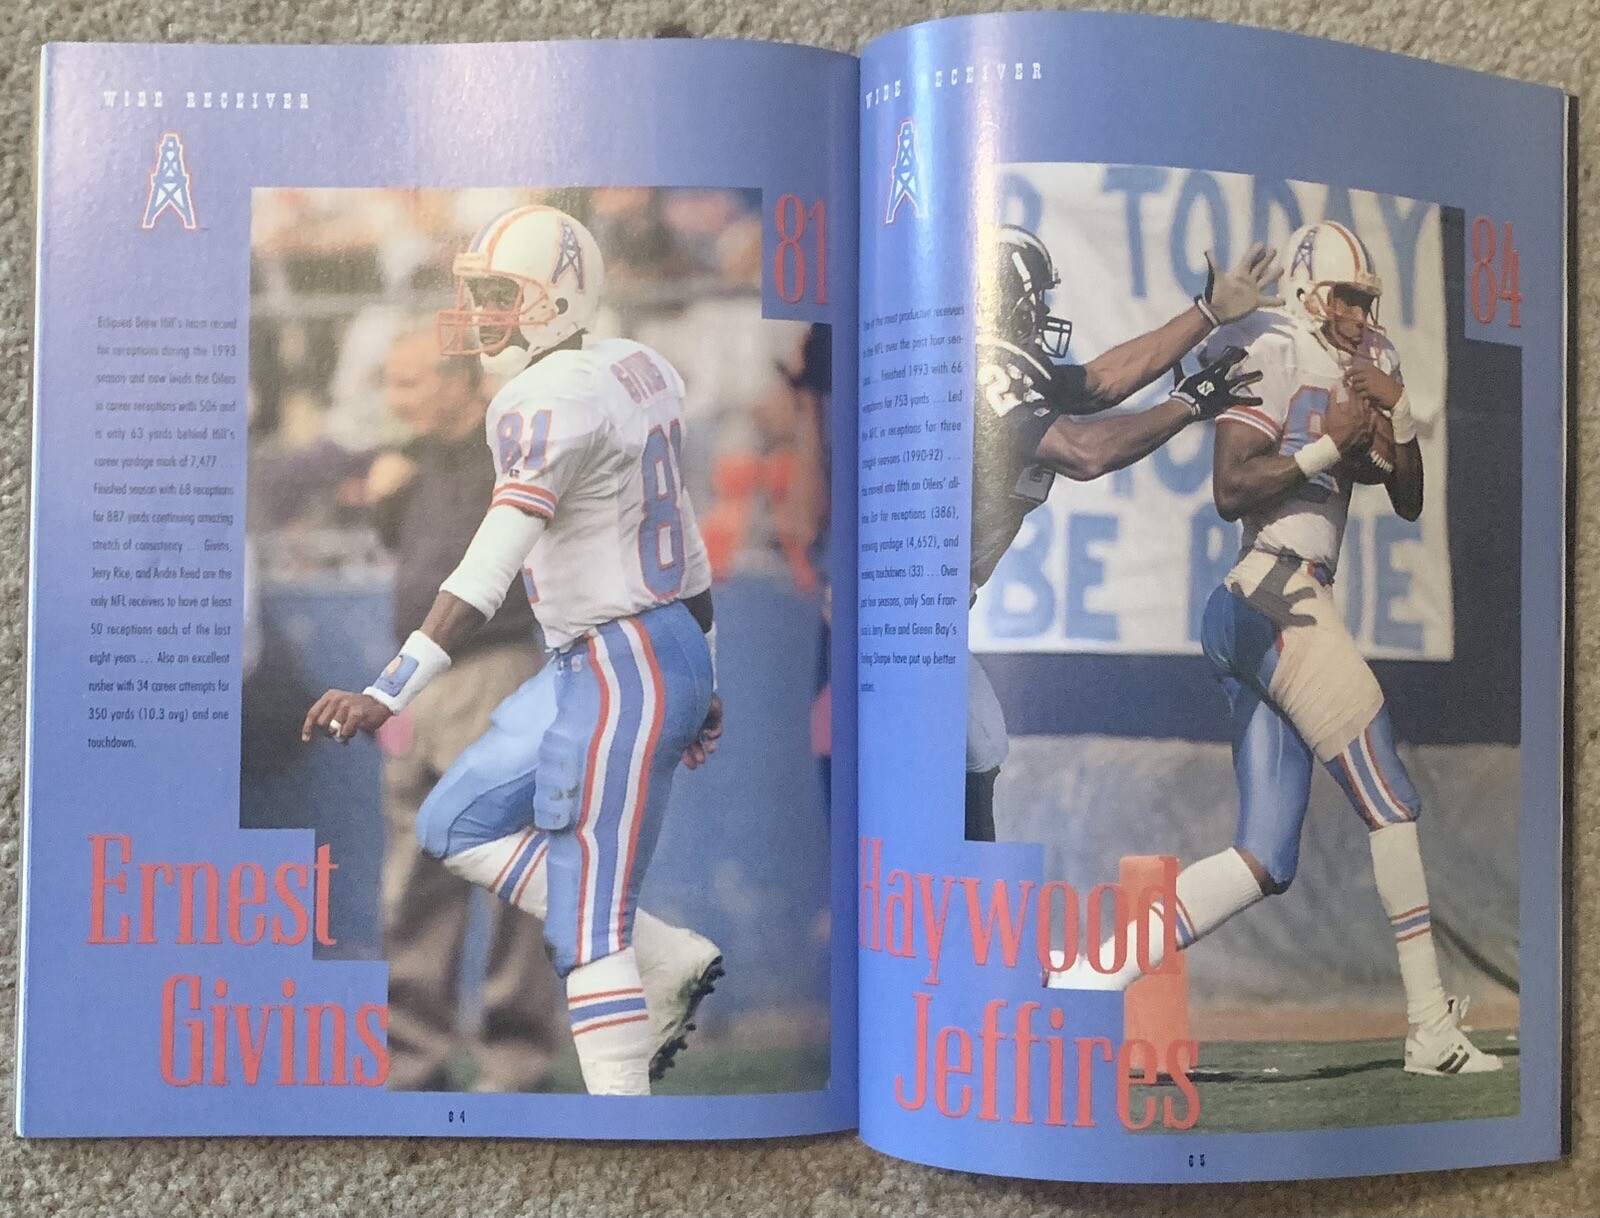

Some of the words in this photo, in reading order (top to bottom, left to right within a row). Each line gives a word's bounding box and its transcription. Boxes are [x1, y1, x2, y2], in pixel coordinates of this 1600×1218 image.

[186, 91, 309, 109] RECEIVER
[774, 194, 828, 305] 81
[1470, 215, 1523, 329] 84
[213, 345, 236, 357] 1993
[909, 363, 929, 377] 1993
[951, 361, 963, 374] 66
[219, 401, 236, 411] and
[894, 394, 908, 407] 753
[910, 392, 930, 408] yards
[948, 390, 963, 402] Led
[925, 420, 937, 432] for
[940, 420, 962, 431] three
[107, 429, 125, 440] only
[131, 428, 143, 439] 63
[149, 428, 173, 441] yards
[177, 428, 208, 439] behind
[496, 410, 552, 478] 81
[156, 456, 177, 467] mark
[179, 455, 188, 467] of
[902, 448, 943, 462] (1990-92)
[159, 484, 177, 495] with
[193, 485, 234, 497] receptions
[93, 510, 104, 522] for
[107, 510, 124, 522] 887
[128, 511, 150, 524] yards
[152, 512, 194, 526] continuing
[197, 512, 233, 526] amazing
[92, 538, 119, 550] stretch
[123, 538, 132, 550] of
[135, 540, 183, 553] consistency
[943, 534, 959, 547] and
[91, 567, 111, 580] Jerry
[113, 566, 133, 580] Rice,
[135, 567, 151, 578] and
[153, 567, 177, 579] Andre
[180, 567, 200, 579] Reed
[203, 569, 216, 579] are
[218, 568, 232, 579] the
[908, 565, 924, 578] (33)
[941, 564, 958, 577] Over
[988, 503, 1121, 642] BE
[91, 596, 107, 608] only
[110, 595, 126, 607] NFL
[129, 596, 165, 607] receivers
[167, 597, 176, 607] to
[178, 595, 198, 607] have
[201, 597, 209, 607] at
[212, 595, 232, 607] least
[904, 593, 919, 608] only
[921, 593, 935, 606] San
[90, 623, 103, 635] 50
[107, 623, 152, 636] receptions
[157, 623, 178, 635] each
[182, 623, 192, 635] of
[196, 623, 210, 635] the
[214, 623, 231, 635] last
[898, 622, 910, 635] and
[912, 622, 933, 635] Green
[936, 622, 957, 637] Bay's
[89, 652, 110, 666] eight
[114, 653, 137, 665] years
[157, 652, 174, 663] Also
[178, 654, 188, 663] an
[192, 652, 230, 664] excellent
[892, 652, 907, 664] have
[909, 653, 920, 666] put
[922, 654, 932, 666] up
[933, 651, 956, 664] better
[88, 680, 113, 691] rusher
[117, 679, 134, 691] with
[137, 679, 149, 691] 34
[151, 682, 176, 692] career
[179, 680, 216, 694] attempts
[218, 679, 229, 691] for
[88, 707, 107, 720] 350
[111, 707, 134, 722] yards
[138, 707, 165, 720] (10.3
[168, 708, 188, 722] avg)
[192, 708, 209, 719] and
[212, 710, 229, 720] one
[88, 736, 137, 748] touchdown.
[86, 833, 338, 946] Ernest
[860, 836, 1181, 985] Haywood
[160, 973, 391, 1088] Givins
[895, 992, 1201, 1131] Jeffires
